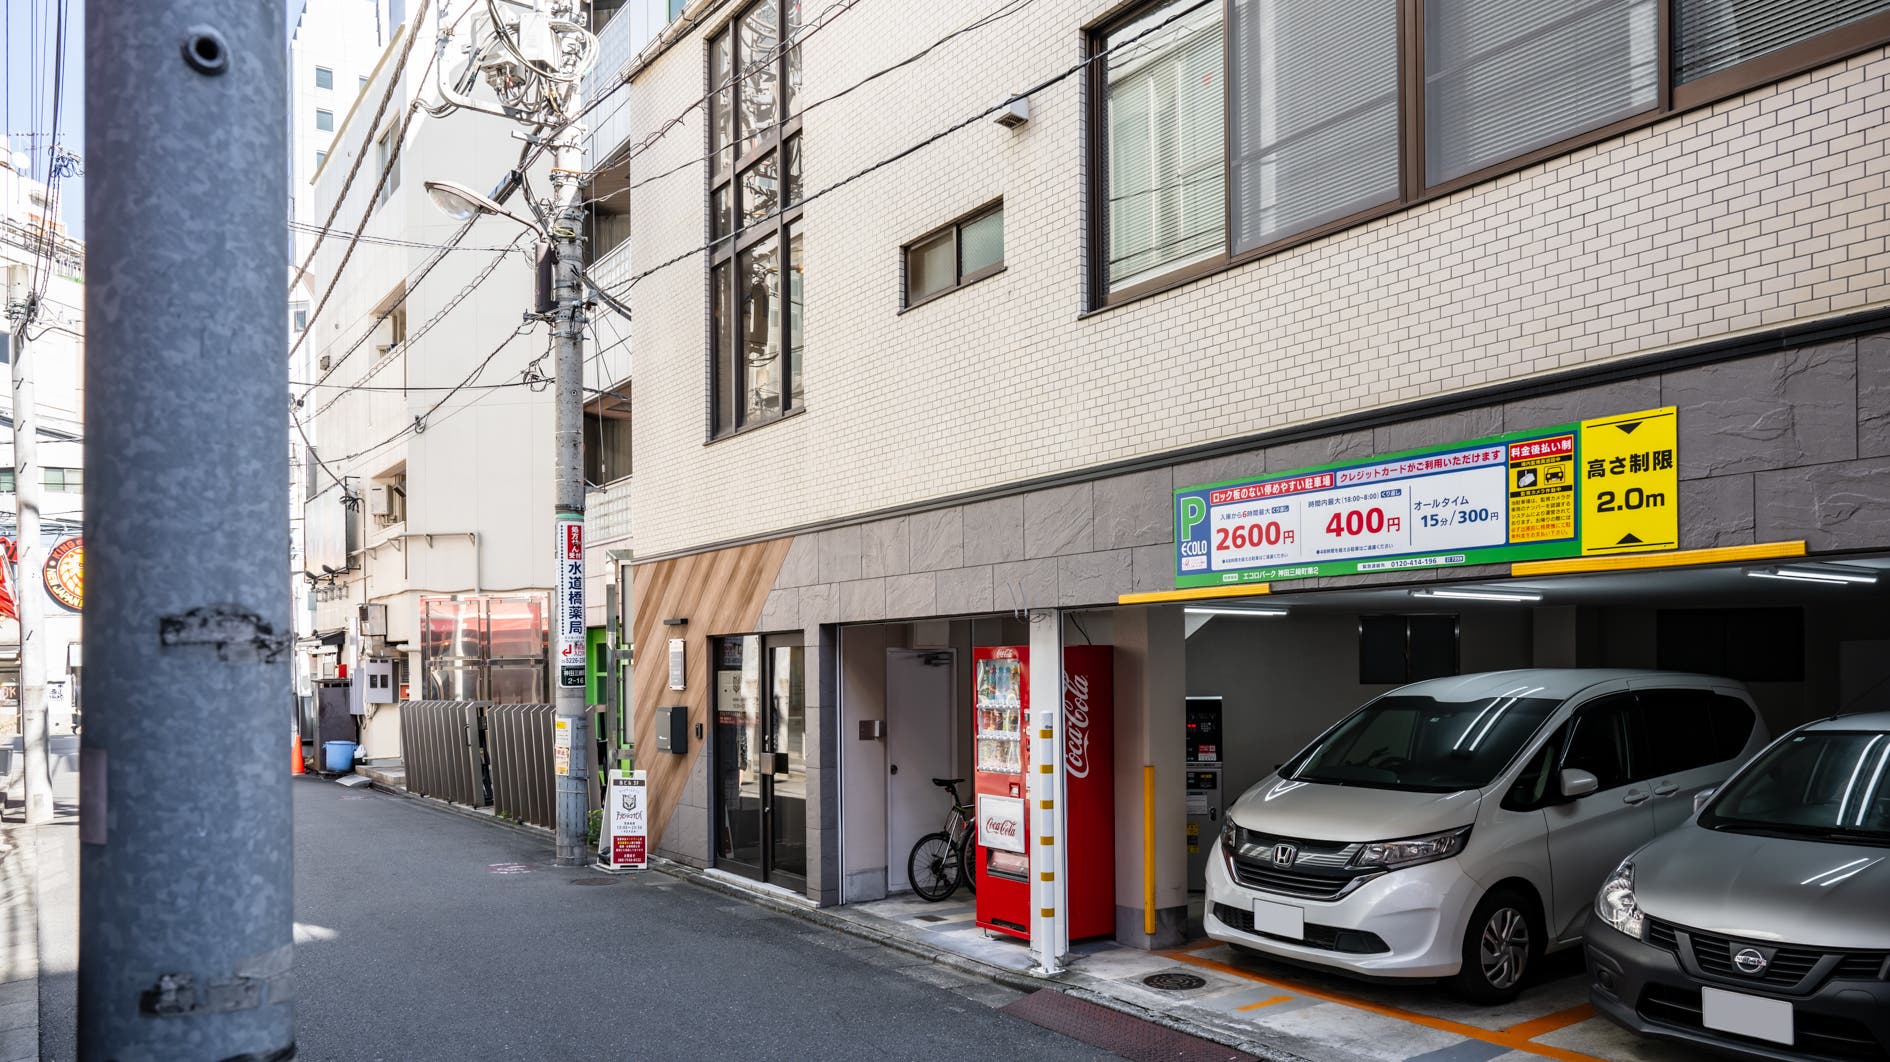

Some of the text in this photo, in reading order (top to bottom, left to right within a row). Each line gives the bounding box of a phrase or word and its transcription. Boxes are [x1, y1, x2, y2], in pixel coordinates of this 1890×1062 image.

[1511, 439, 1572, 458] 料金後払い制
[1340, 450, 1501, 483] クレジットカードがご利用いただけます
[1587, 449, 1673, 479] 高さ制限
[1213, 475, 1332, 503] ロック板のない停めやすい駐車場
[1597, 487, 1665, 513] 2.0m
[1414, 496, 1469, 510] オールタイム
[1181, 496, 1206, 541] P
[1181, 540, 1207, 556] ECOLO
[1243, 570, 1276, 580] エコロパーク
[1391, 558, 1437, 568] 0120-414-196
[568, 561, 583, 635] 水道橋薬局
